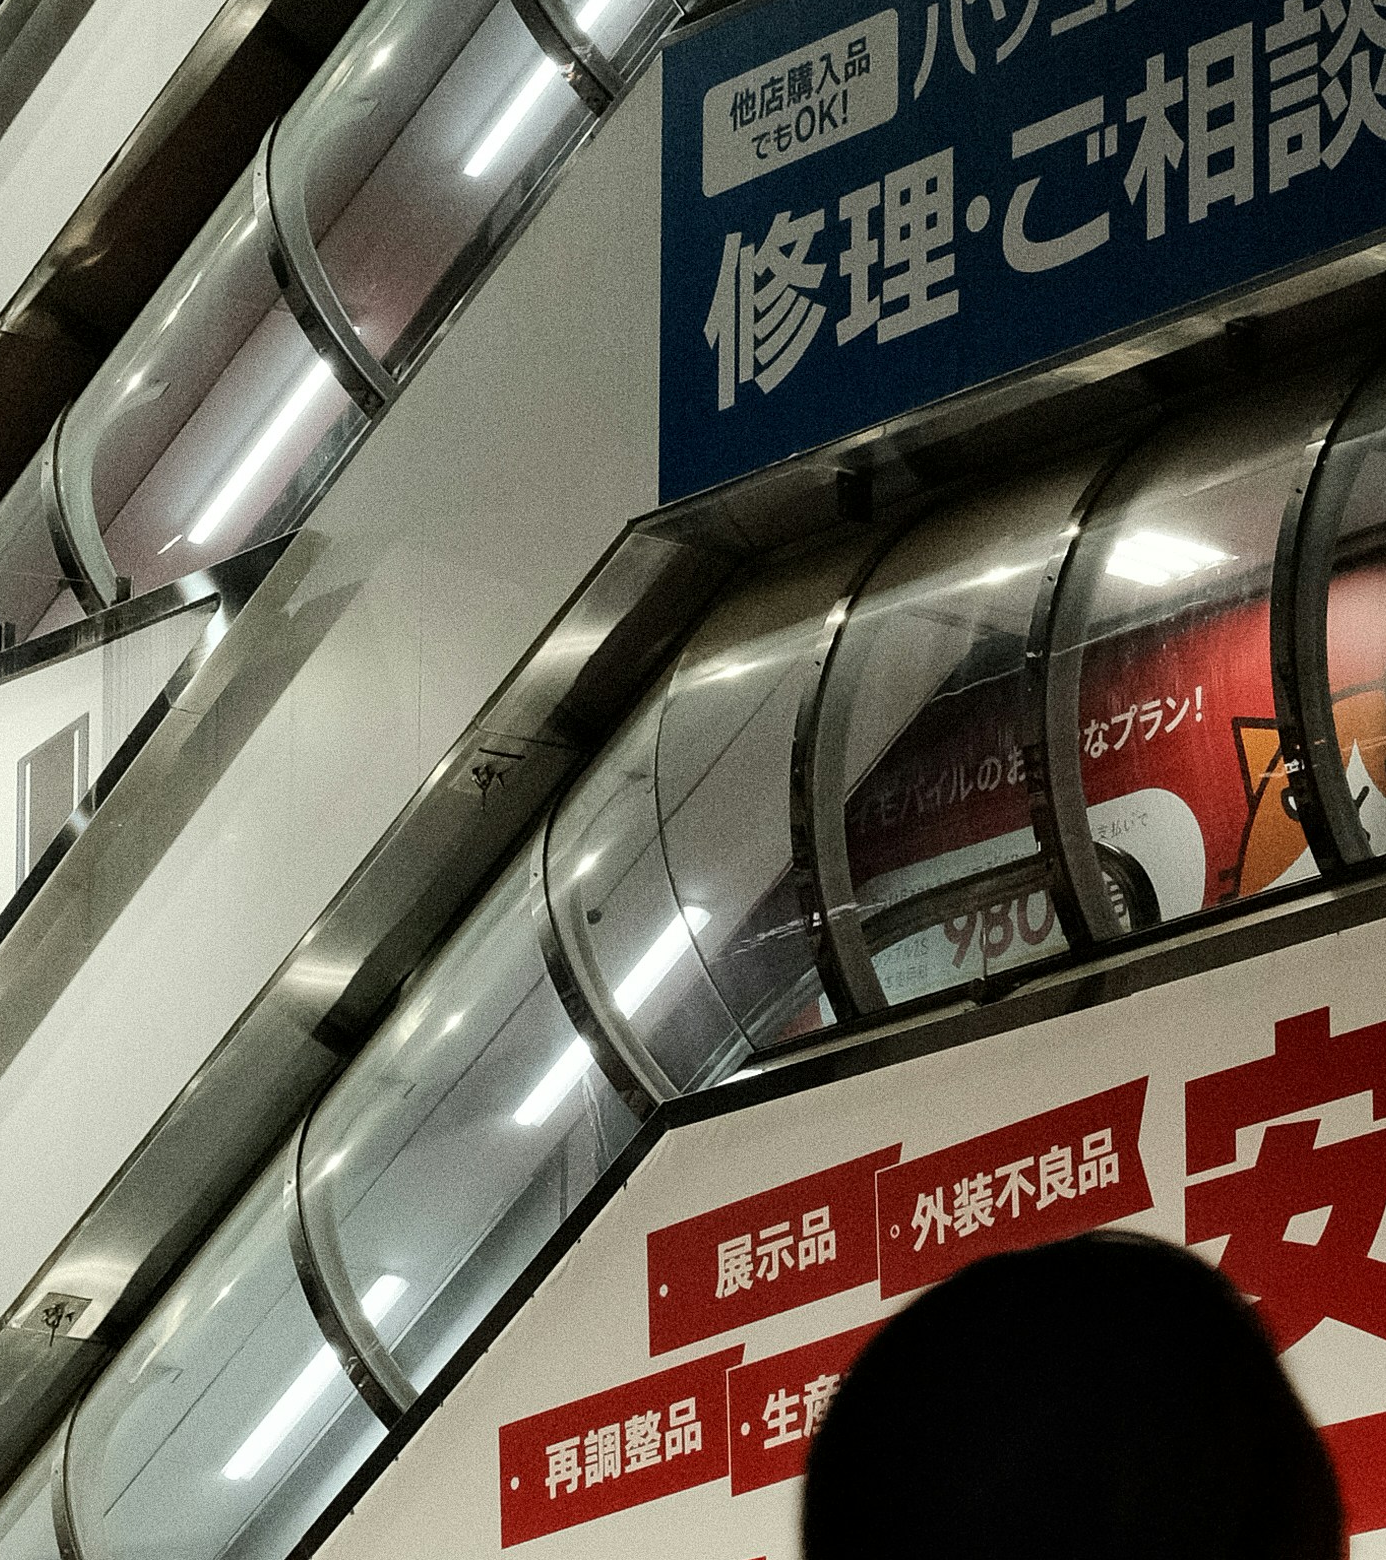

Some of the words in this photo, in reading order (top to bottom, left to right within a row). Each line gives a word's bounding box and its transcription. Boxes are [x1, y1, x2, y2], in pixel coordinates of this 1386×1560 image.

[729, 40, 873, 132] 他店購入品
[751, 88, 850, 163] でもOK!
[909, 1126, 1122, 1253] 外装不良品
[714, 1206, 839, 1301] 展示品
[544, 1395, 704, 1500] 再調整品
